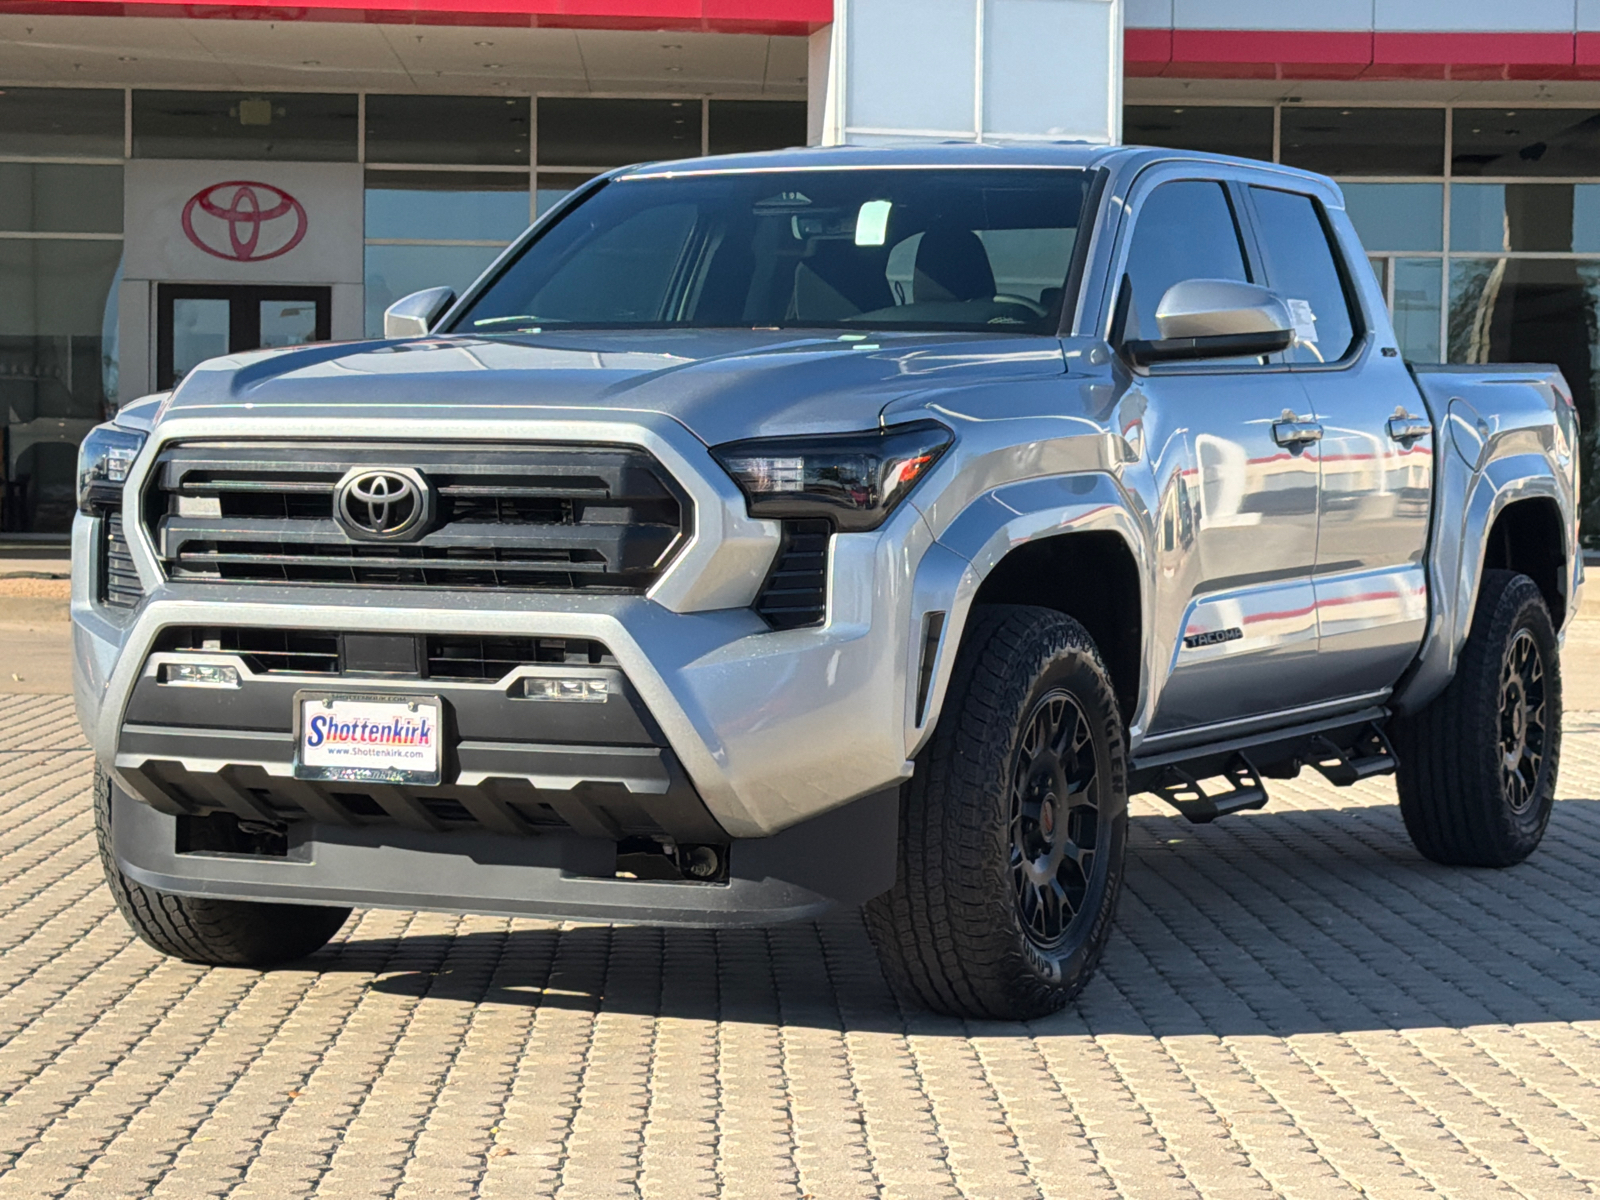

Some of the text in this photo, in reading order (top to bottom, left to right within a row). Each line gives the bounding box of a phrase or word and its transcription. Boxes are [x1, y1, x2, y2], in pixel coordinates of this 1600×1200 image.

[1186, 628, 1243, 647] TACOMA
[307, 714, 432, 747] Shottenkirk
[327, 747, 424, 758] www.Shottenkirk.com
